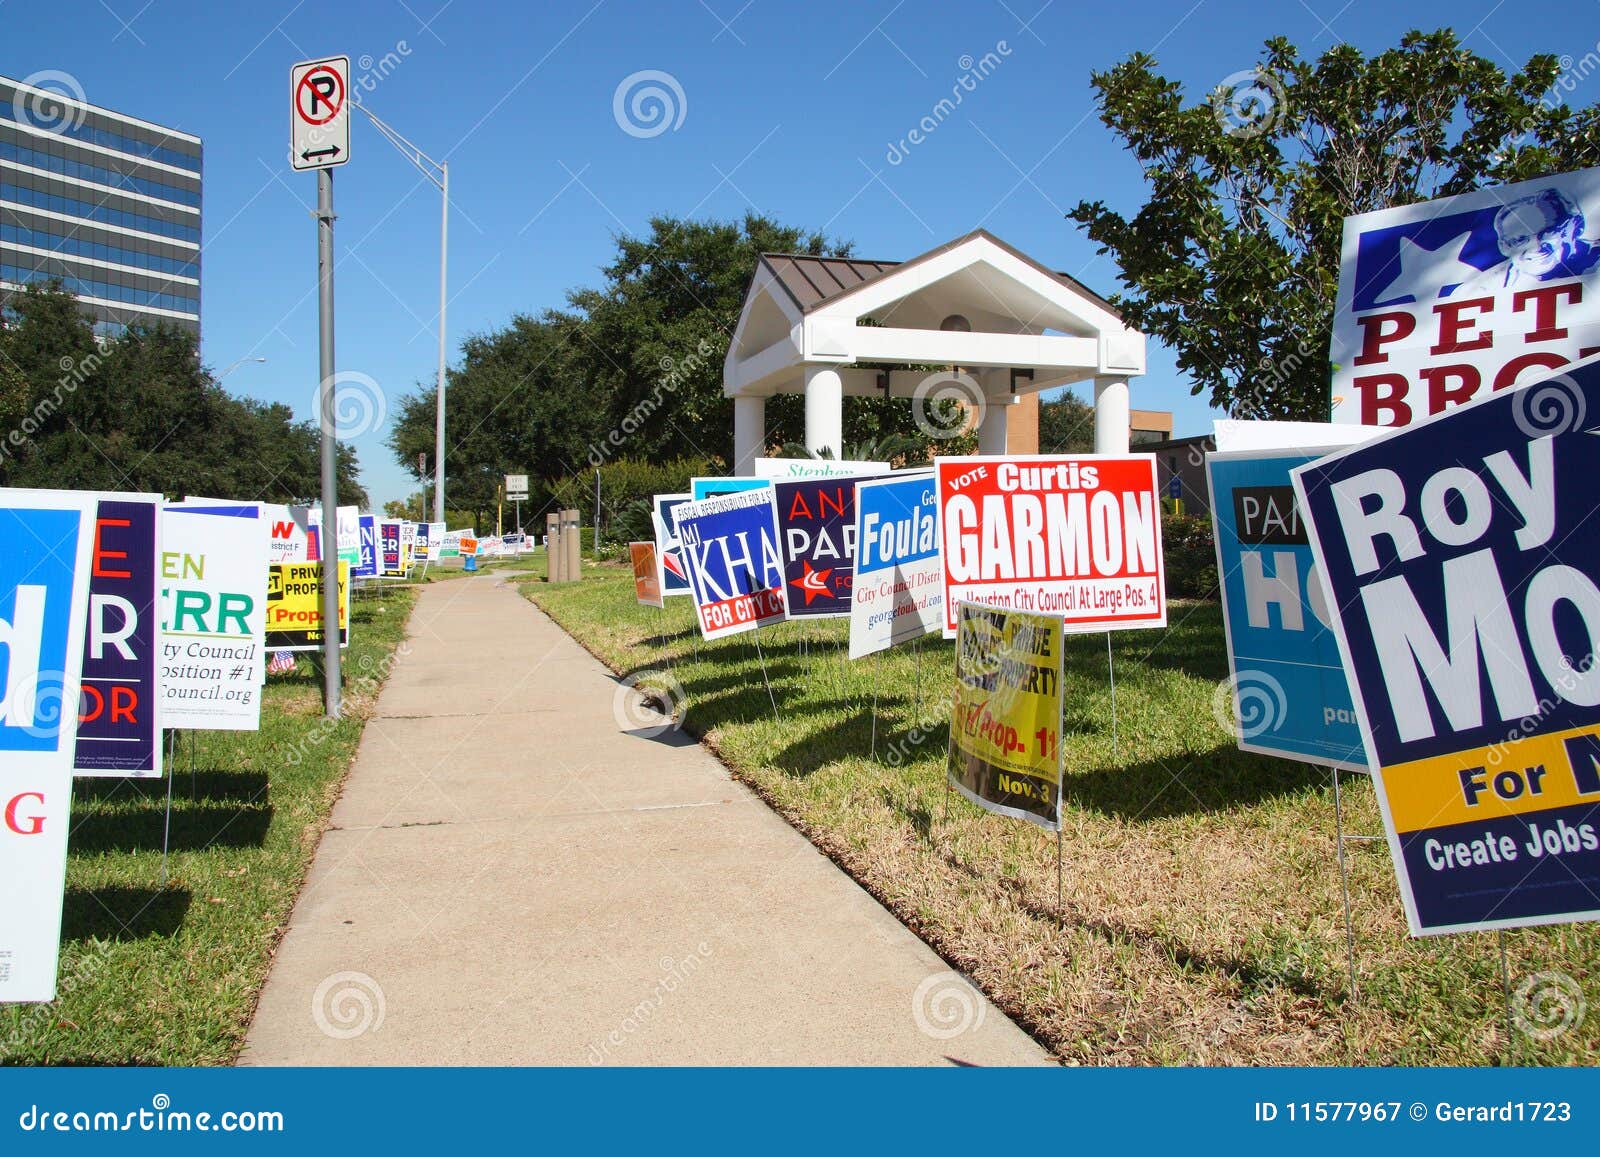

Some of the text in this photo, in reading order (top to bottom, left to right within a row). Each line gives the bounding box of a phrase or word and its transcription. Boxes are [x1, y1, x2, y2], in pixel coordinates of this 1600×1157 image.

[312, 77, 336, 115] P
[1353, 283, 1583, 366] PET
[948, 466, 989, 491] VOTE
[996, 462, 1100, 492] Curtis
[1330, 434, 1556, 577] Roy
[680, 523, 701, 548] MJ
[945, 490, 1158, 583] GARMON
[162, 552, 206, 580] EN
[361, 547, 373, 565] 4
[857, 585, 877, 605] City
[880, 574, 915, 598] Council
[1038, 585, 1076, 612] Council
[1079, 585, 1090, 609] At
[1093, 584, 1122, 614] Large
[1124, 583, 1147, 607] Pos.
[1150, 582, 1157, 607] 4
[90, 593, 138, 660] R
[162, 588, 254, 635] RR
[275, 608, 325, 625] Prop.
[702, 603, 734, 630] FOR
[735, 595, 765, 622] CITY
[187, 642, 256, 660] Council
[229, 664, 253, 681] #1
[161, 684, 253, 705] ouncil.org
[979, 711, 1025, 757] Prop.
[1035, 726, 1056, 761] 11
[998, 773, 1050, 803] Nov. 3
[1458, 764, 1547, 807] For
[4, 792, 47, 834] G
[1424, 819, 1599, 872] Create Jobs
